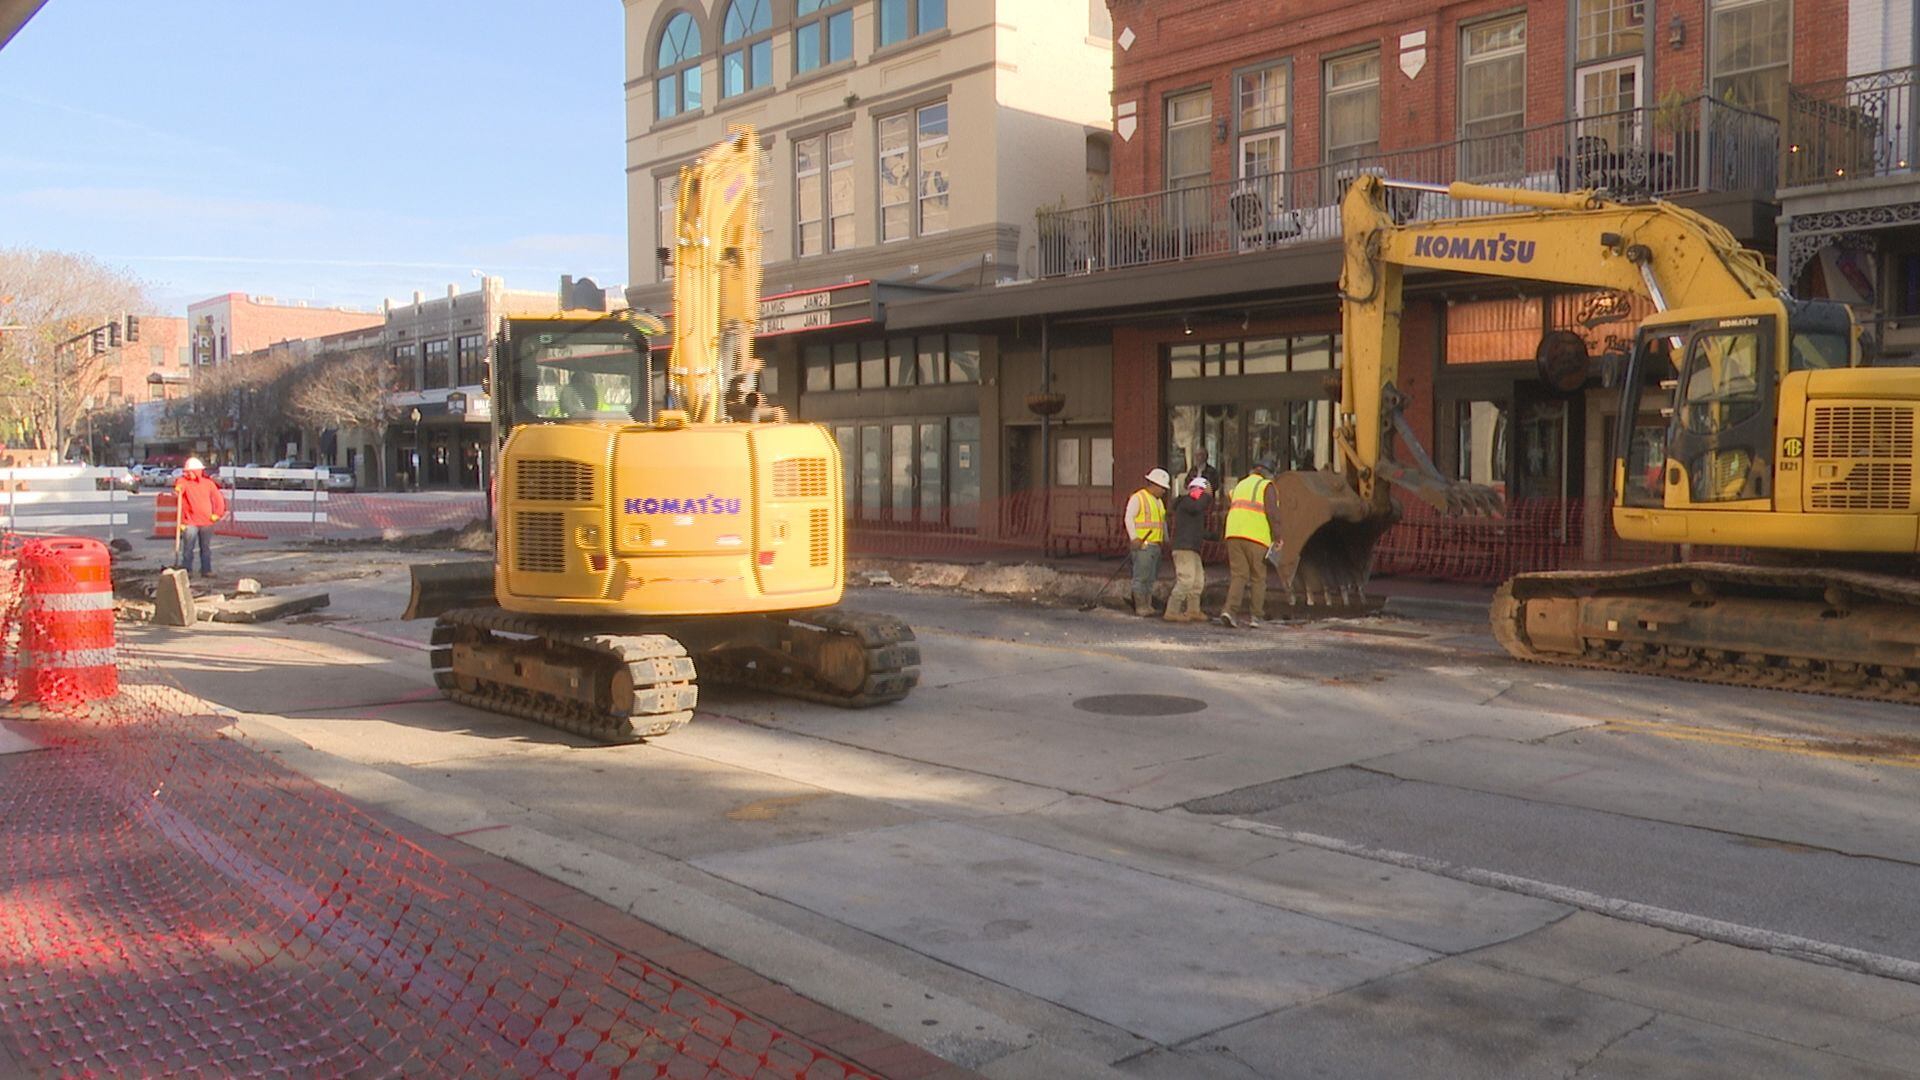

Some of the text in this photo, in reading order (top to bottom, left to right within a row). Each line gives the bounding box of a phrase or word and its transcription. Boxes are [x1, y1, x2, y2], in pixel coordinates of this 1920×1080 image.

[1415, 232, 1536, 264] KOMATSU
[1719, 317, 1759, 328] KOMATSU
[623, 493, 741, 515] KOMATSU
